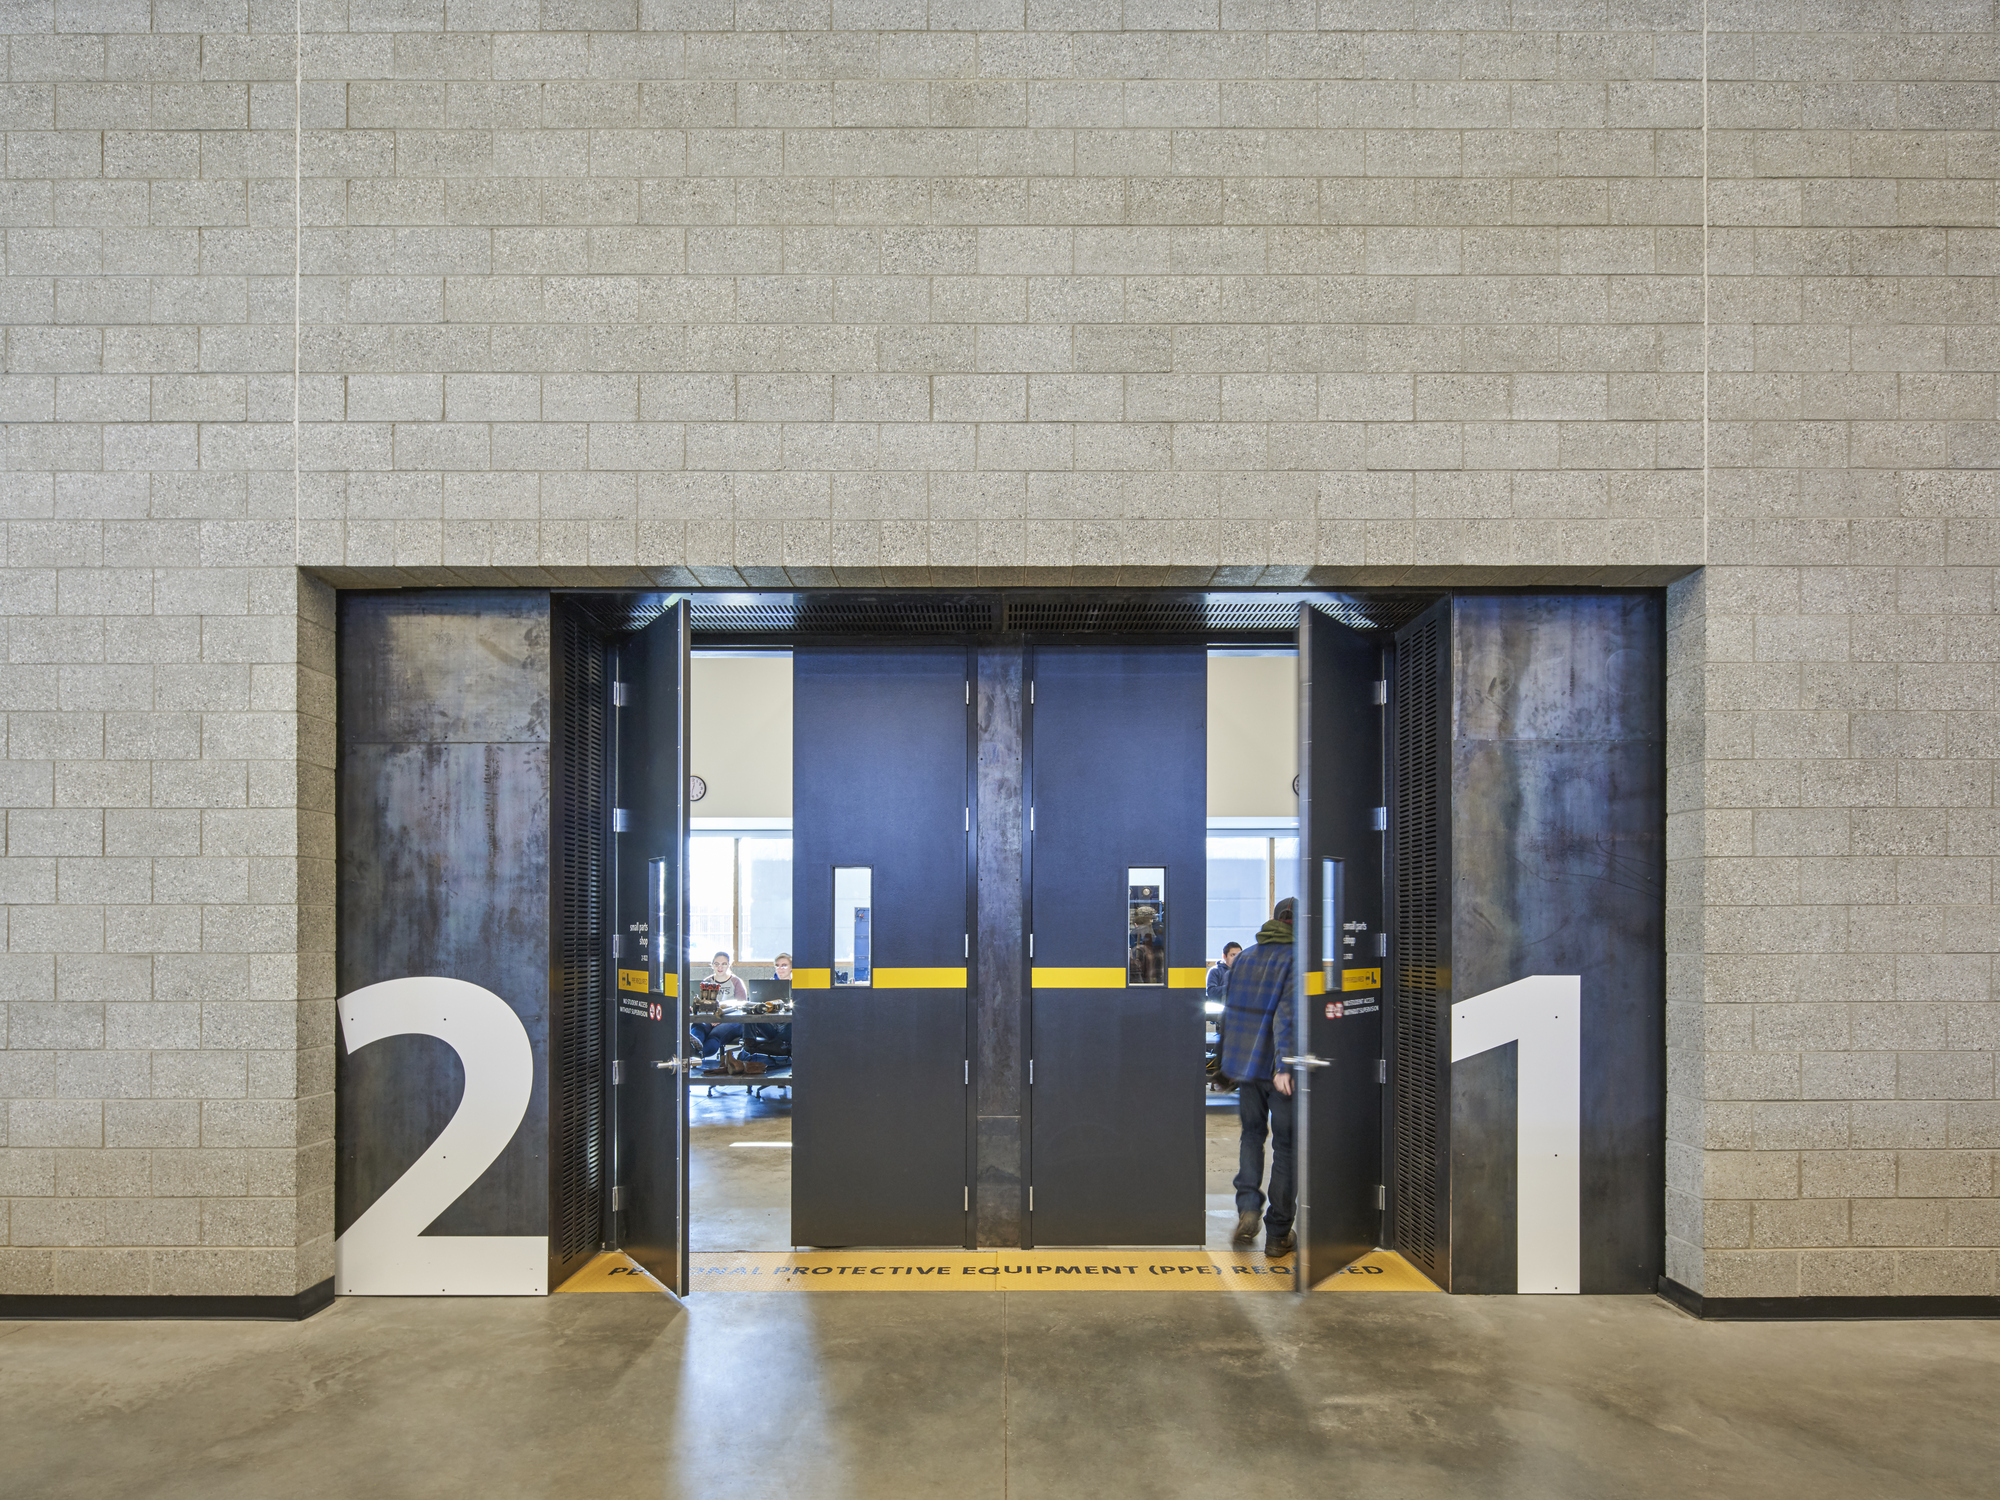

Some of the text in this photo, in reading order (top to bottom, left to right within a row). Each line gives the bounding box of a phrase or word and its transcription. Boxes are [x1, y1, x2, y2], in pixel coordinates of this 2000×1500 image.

[630, 922, 648, 933] small parts
[639, 936, 648, 947] shop
[334, 976, 549, 1296] 2
[1451, 975, 1581, 1294] 1
[607, 1264, 1384, 1276] PEONAL PROTECTIVE EQUIPMENT (PPE) REQED
